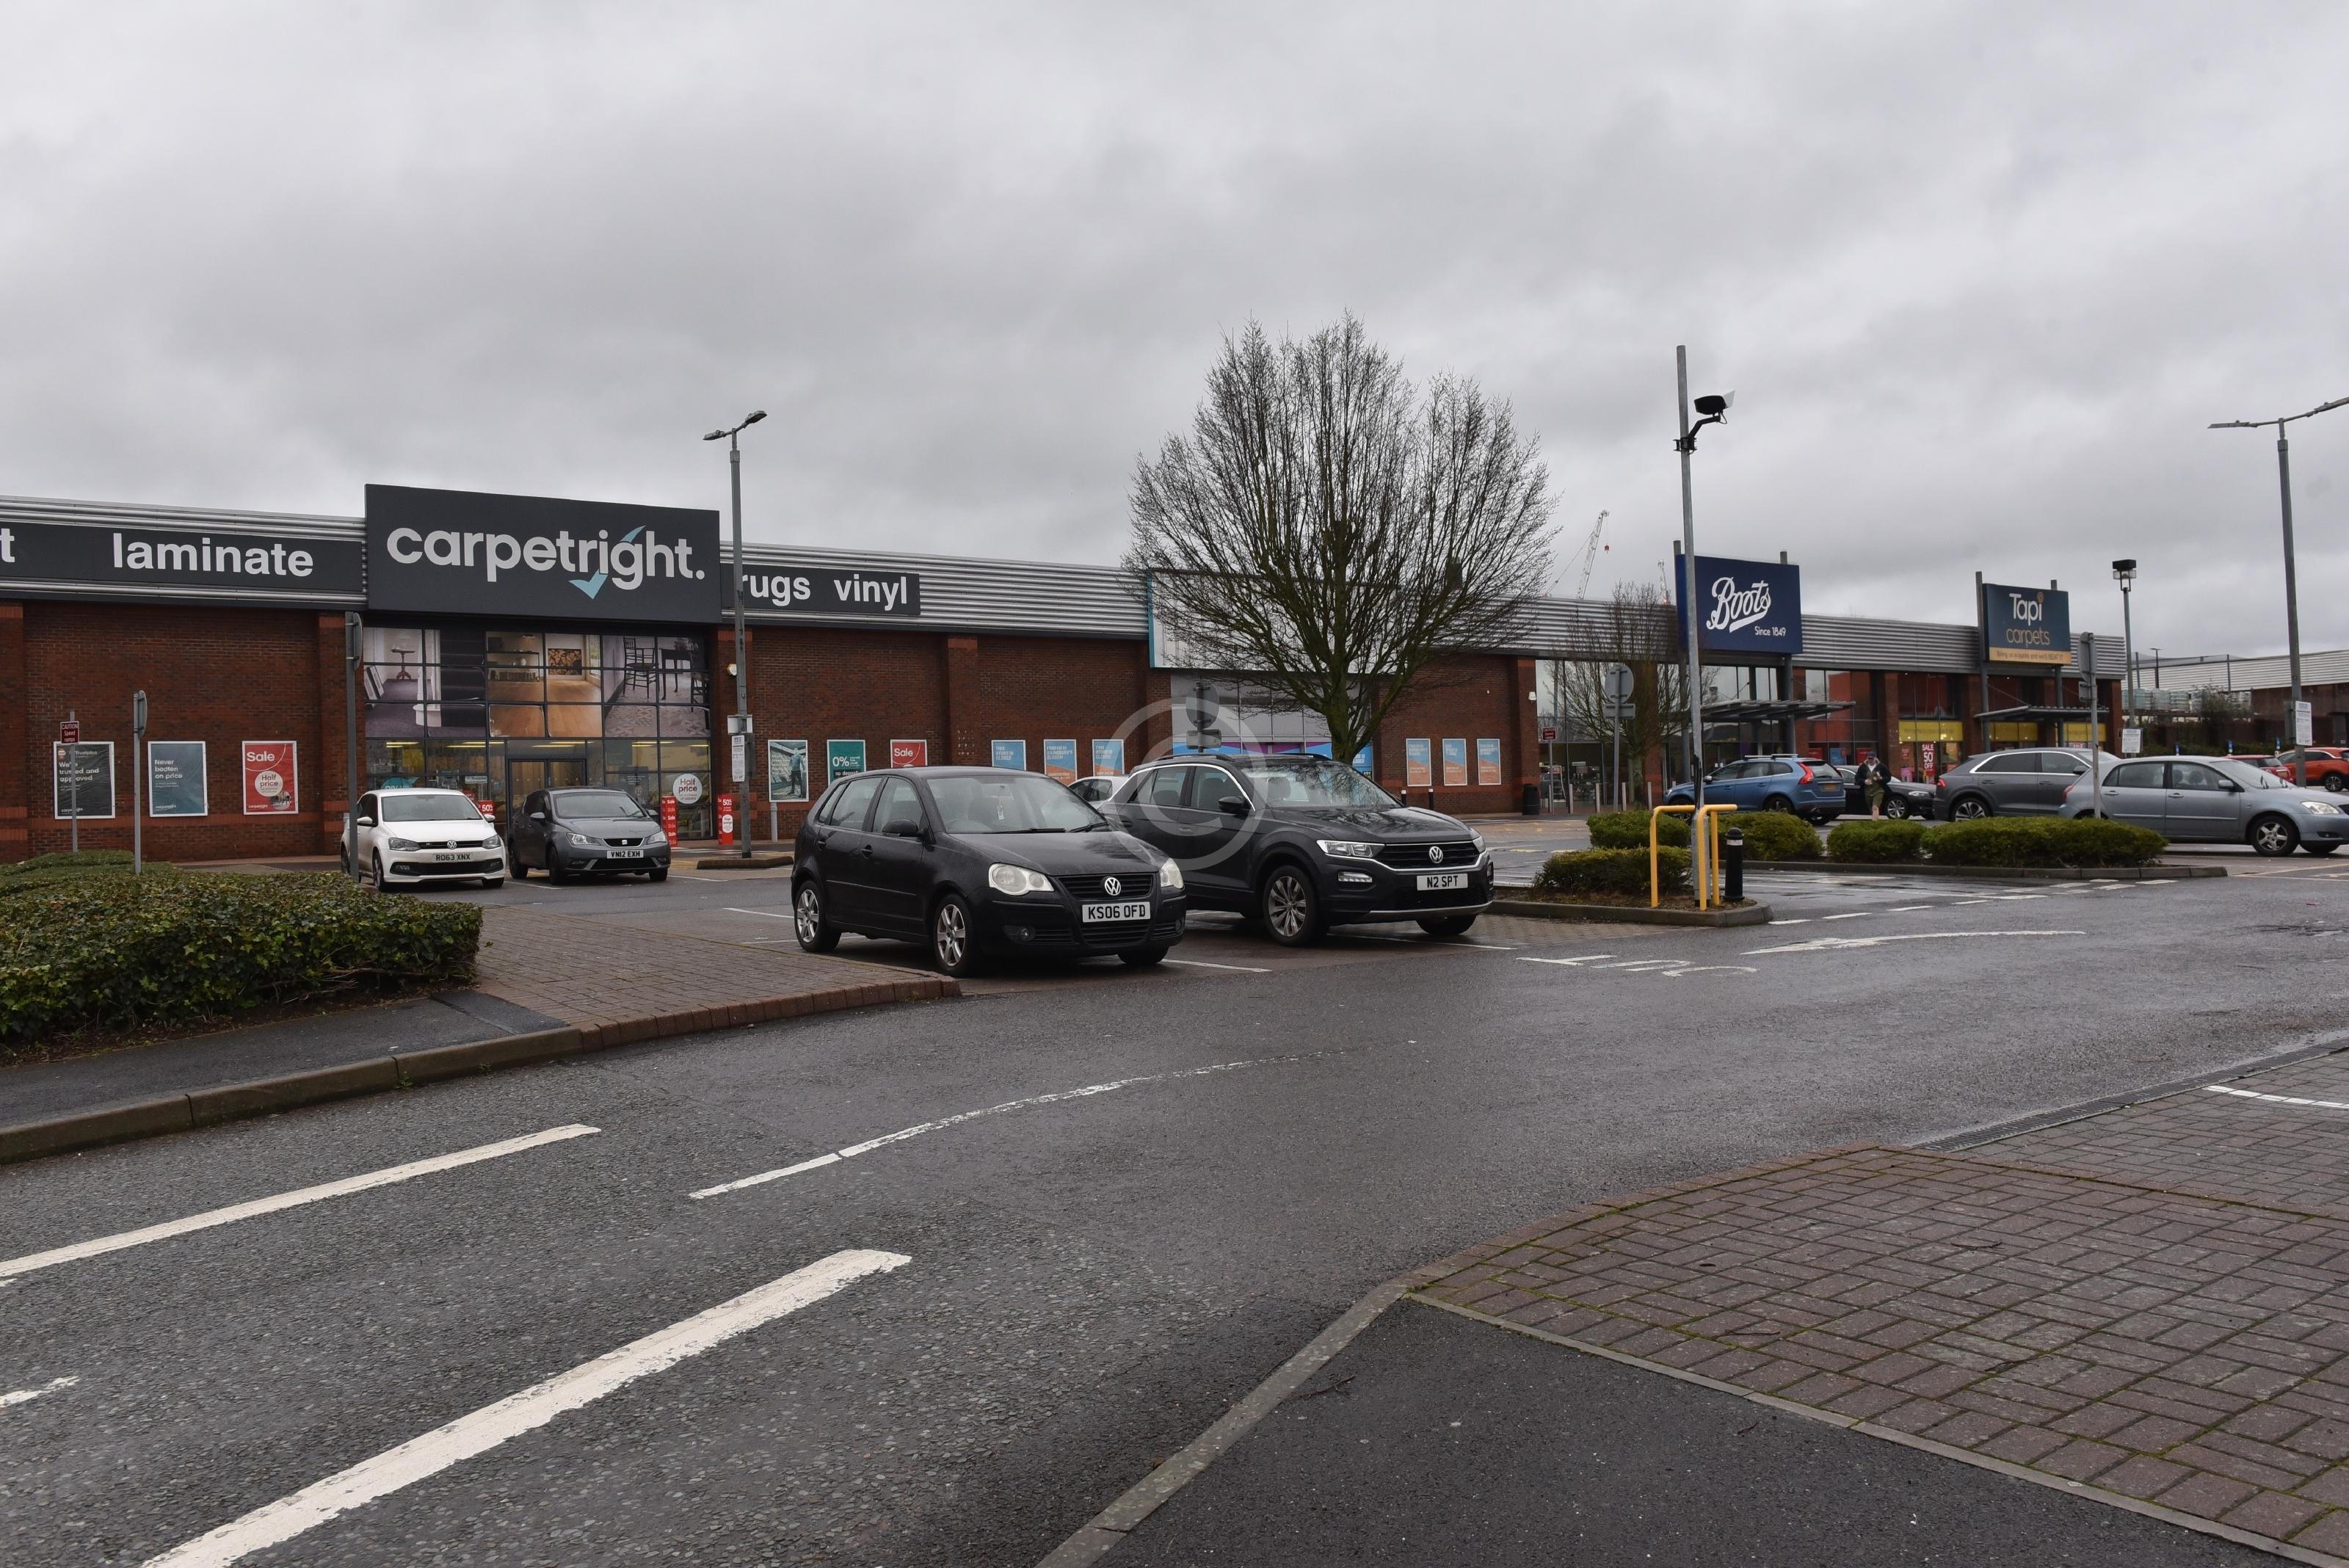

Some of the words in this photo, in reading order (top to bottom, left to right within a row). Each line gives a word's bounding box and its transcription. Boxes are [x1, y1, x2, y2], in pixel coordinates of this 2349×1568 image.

[113, 533, 313, 577] laminate
[834, 573, 907, 611] vinyl
[1706, 577, 1771, 634] Boots
[2008, 592, 2044, 626] Tapi
[1754, 625, 1771, 636] Since
[1771, 626, 1787, 637] 1849
[2006, 626, 2050, 648] carpets
[247, 751, 275, 761] Sale
[894, 748, 913, 757] Sale
[1923, 752, 1934, 763] 50
[832, 756, 849, 766] 0%
[1426, 876, 1439, 888] N2
[1441, 876, 1458, 887] SPT
[1088, 906, 1120, 919] KS06
[1124, 904, 1145, 918] OFD
